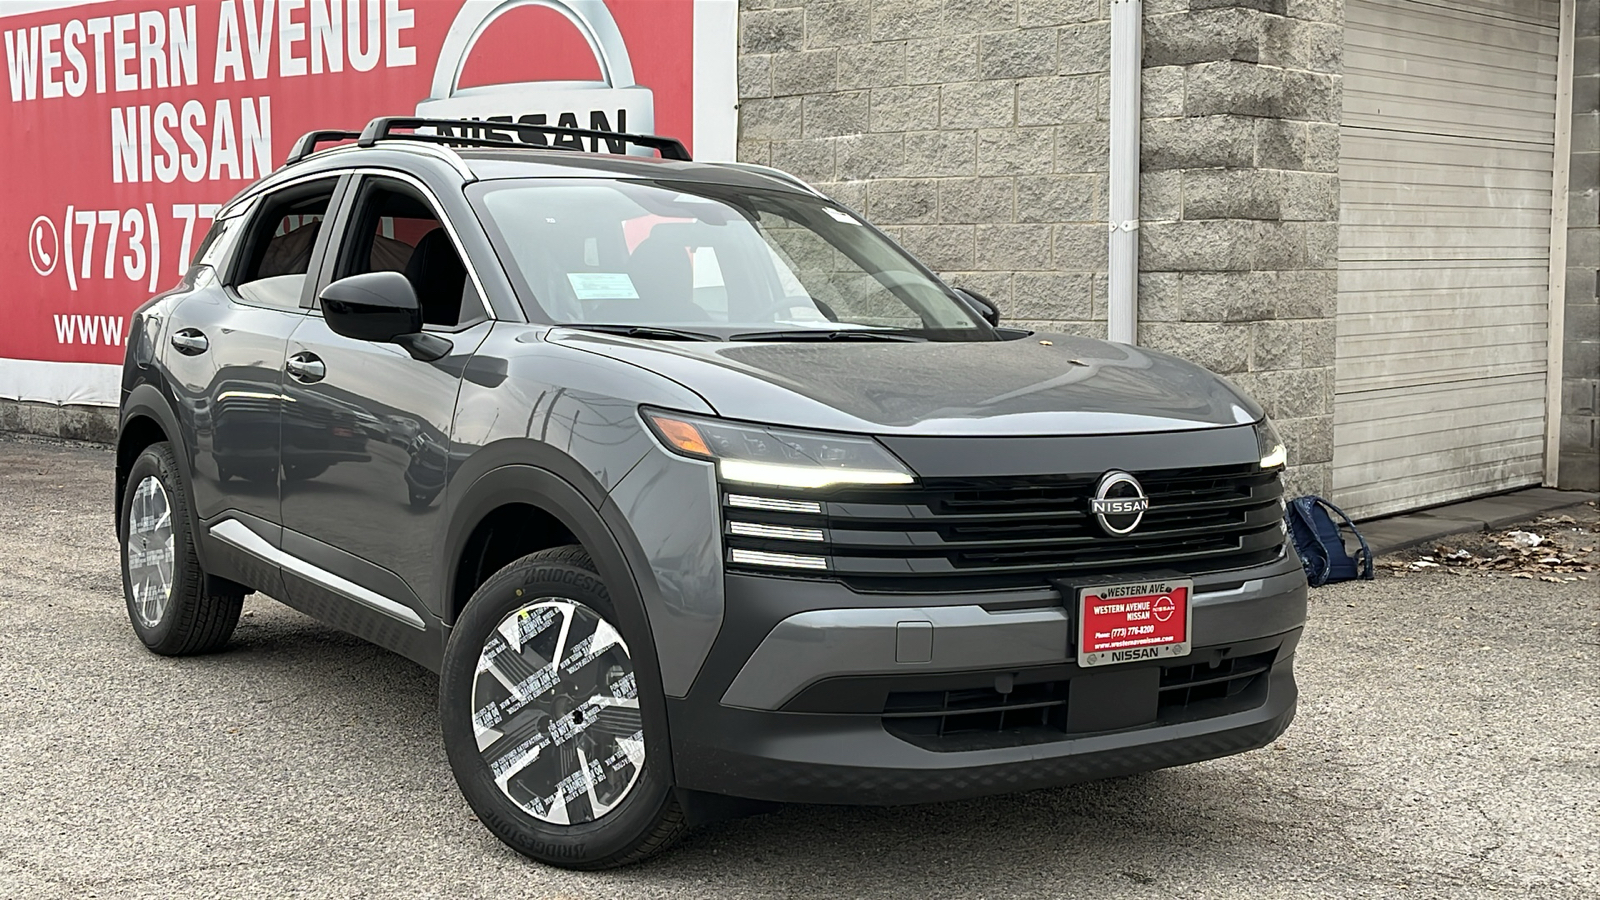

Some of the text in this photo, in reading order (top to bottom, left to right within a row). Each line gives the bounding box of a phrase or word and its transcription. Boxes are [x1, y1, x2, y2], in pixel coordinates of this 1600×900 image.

[4, 0, 417, 102] WESTERN AVENUE
[111, 96, 272, 184] NISSAN
[63, 203, 158, 293] (773)
[1094, 499, 1148, 512] NISSAN
[1108, 585, 1148, 597] WESTERN
[1093, 601, 1151, 615] WESTERN AVENUE
[1127, 611, 1150, 621] NISSAN
[1111, 627, 1127, 639] (773)
[1127, 625, 1155, 636] 776-8200
[1111, 647, 1159, 661] NISSAN
